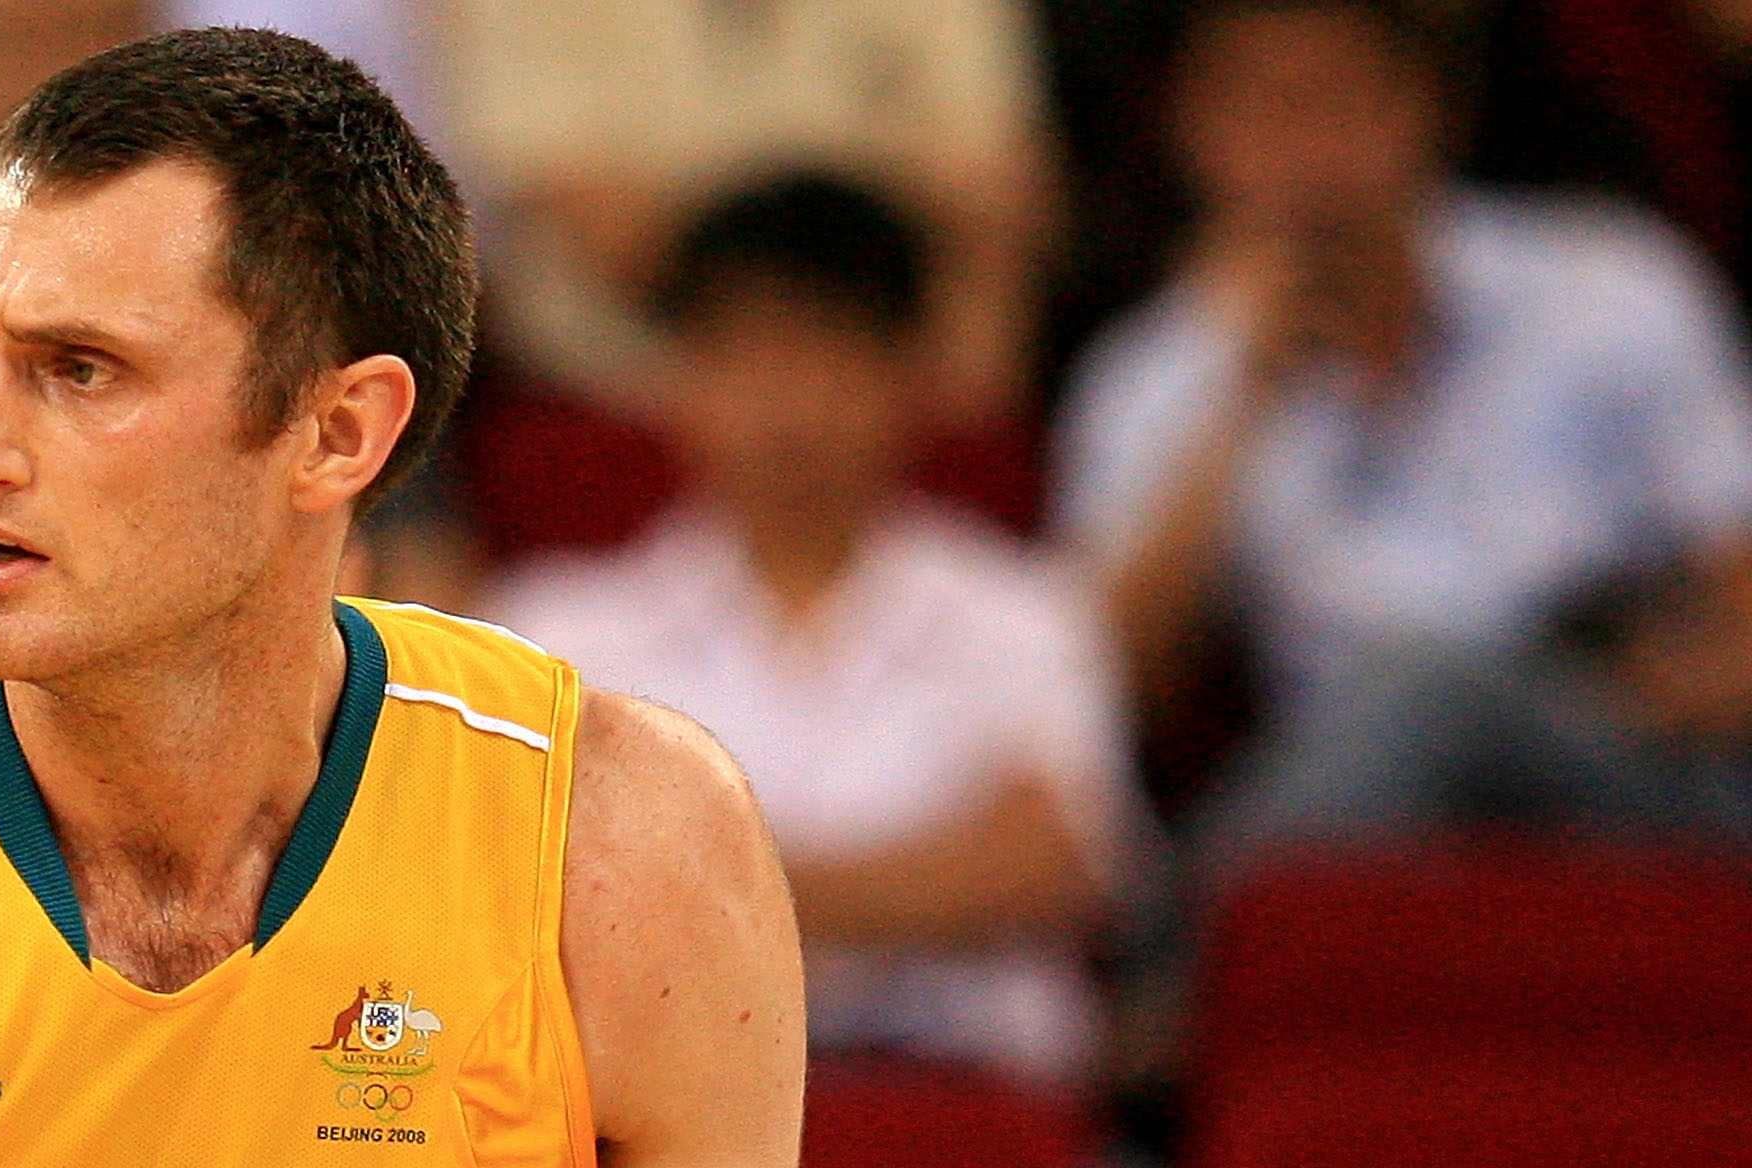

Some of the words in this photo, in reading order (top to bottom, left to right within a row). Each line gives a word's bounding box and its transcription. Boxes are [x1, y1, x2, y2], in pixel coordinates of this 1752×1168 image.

[340, 1054, 418, 1066] AUSTRALIA
[317, 1126, 383, 1142] BEIJING
[387, 1129, 426, 1145] 2008
